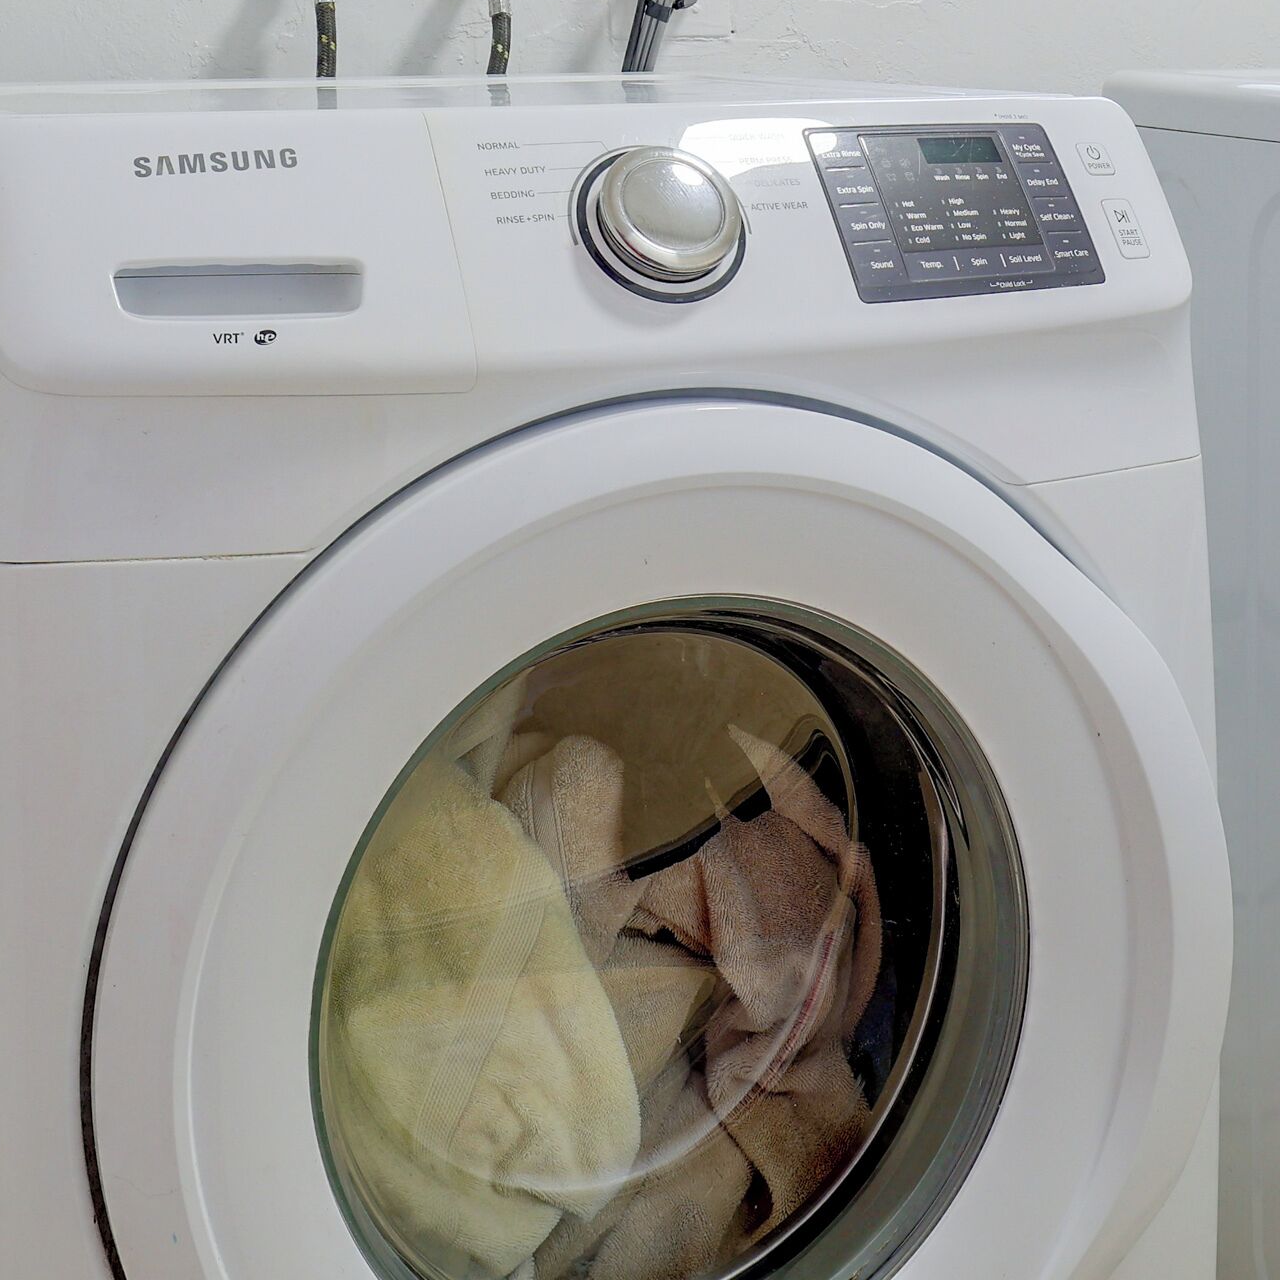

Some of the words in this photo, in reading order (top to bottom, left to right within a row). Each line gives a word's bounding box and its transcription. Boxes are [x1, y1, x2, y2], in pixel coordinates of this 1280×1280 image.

[477, 141, 521, 151] NORMAL
[1012, 144, 1023, 152] My
[1023, 143, 1041, 151] Cycle
[841, 150, 862, 158] Rinse
[133, 148, 298, 178] SAMSUNG
[484, 167, 518, 176] HEAVY
[520, 166, 546, 175] DUTY
[976, 173, 989, 181] Spin
[1026, 179, 1046, 187] Delay
[490, 189, 535, 200] BEDDING
[836, 186, 858, 195] Extra
[858, 185, 874, 194] Spin
[751, 202, 780, 211] ACTIVE
[782, 201, 809, 210] WEAR
[948, 197, 965, 206] High
[952, 209, 979, 217] Medium
[1000, 209, 1020, 217] Heavy
[851, 222, 868, 231] Spin
[868, 221, 886, 230] Only
[924, 223, 944, 231] Warm
[1004, 219, 1027, 227] Normal
[972, 233, 988, 241] Spin
[1009, 232, 1026, 240] Light
[1009, 255, 1022, 263] Soil
[1023, 254, 1043, 262] Level
[1054, 250, 1074, 259] Smart
[1074, 249, 1089, 257] Care
[870, 260, 894, 269] Sound
[920, 260, 944, 269] Temp.
[971, 258, 988, 266] Spin
